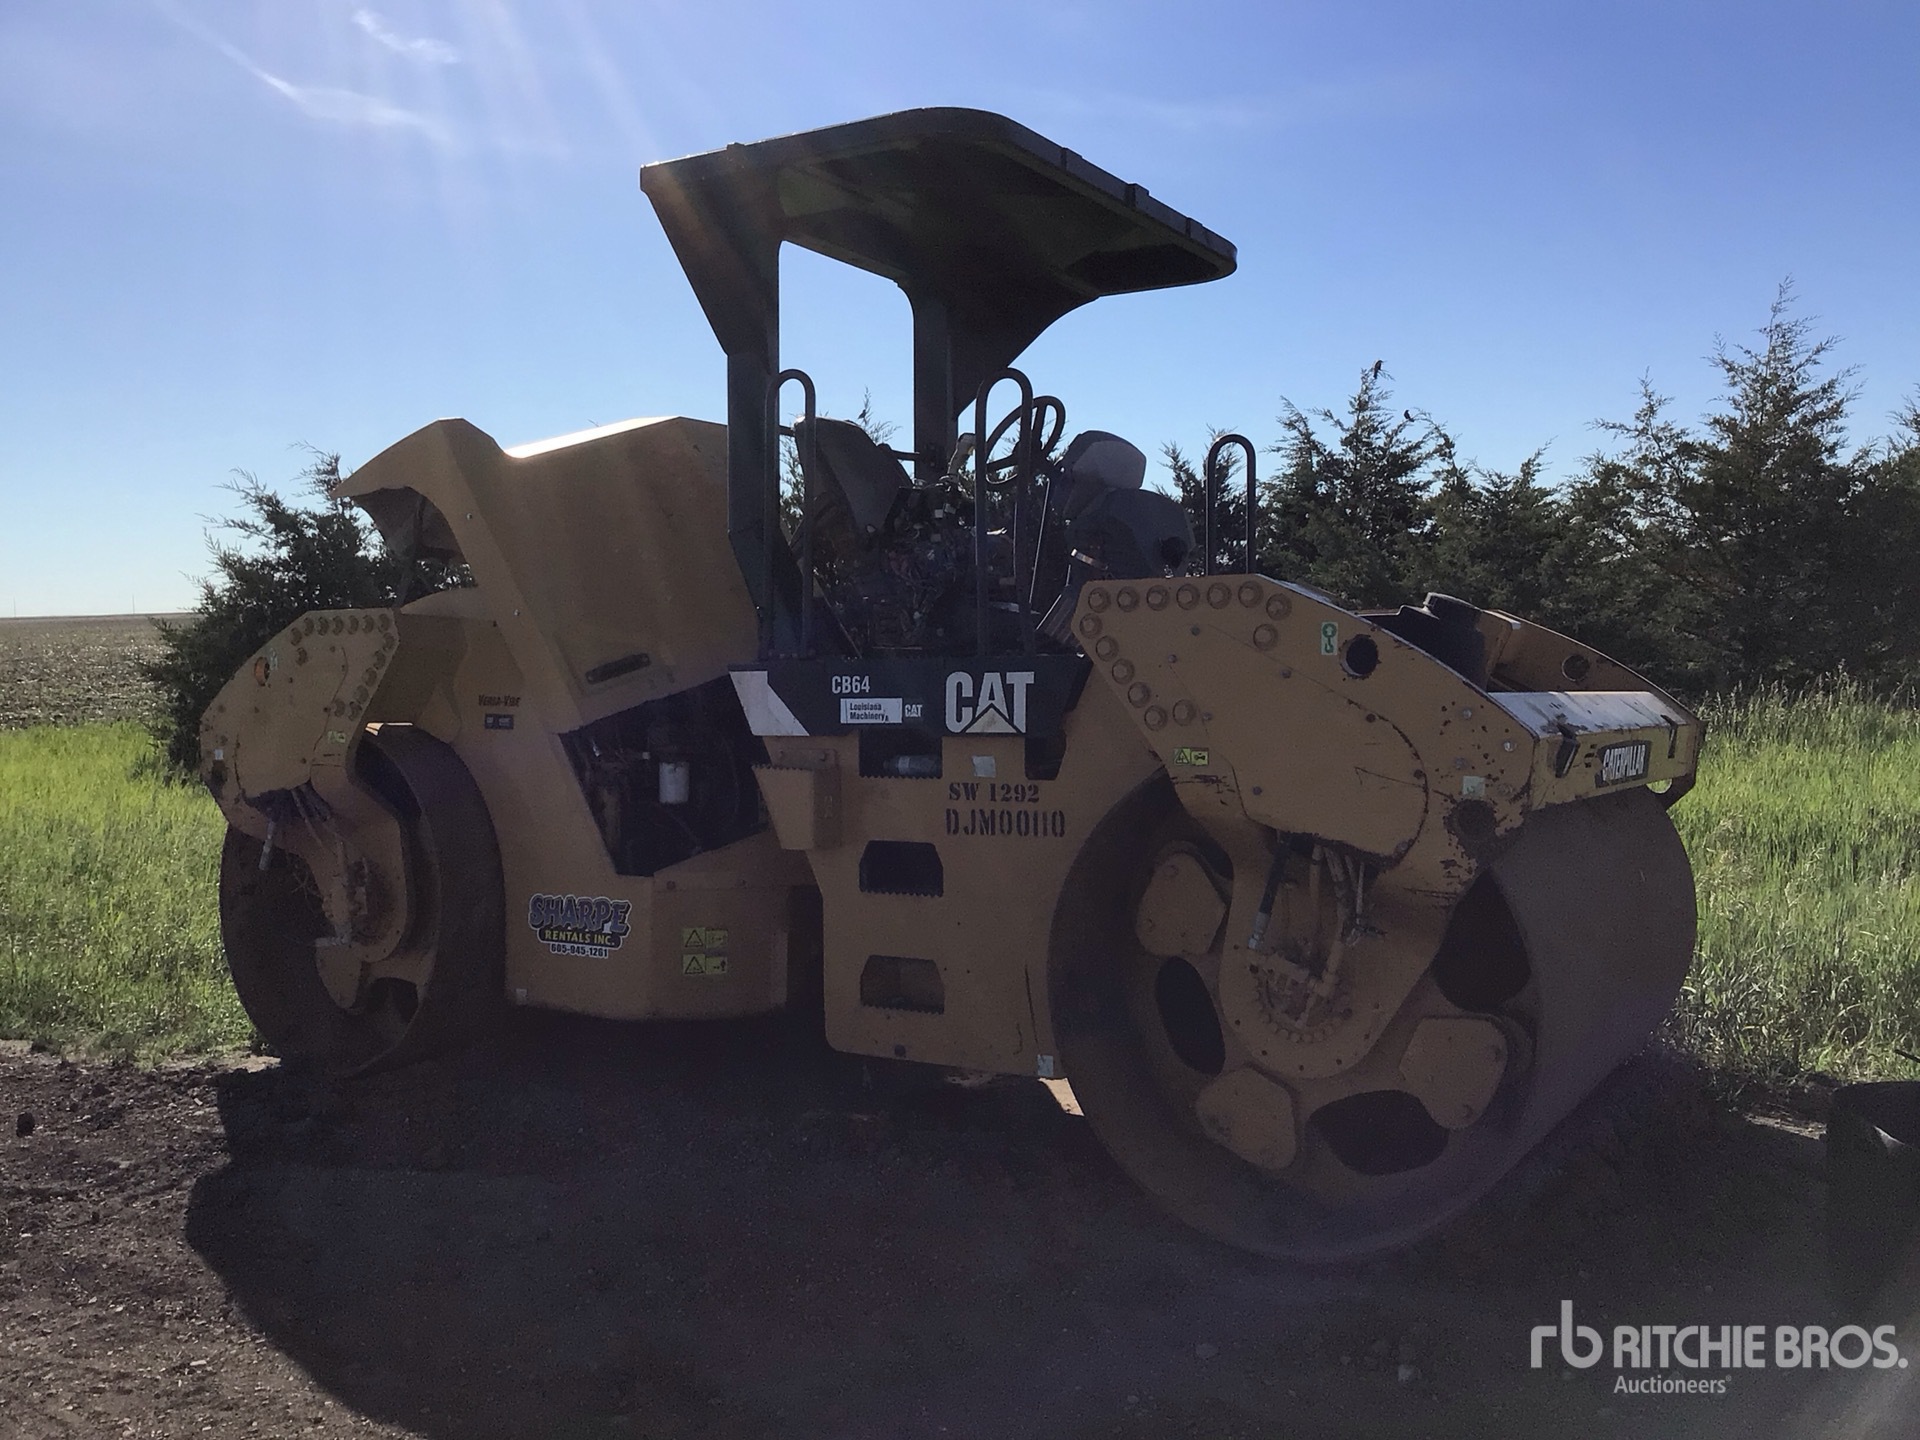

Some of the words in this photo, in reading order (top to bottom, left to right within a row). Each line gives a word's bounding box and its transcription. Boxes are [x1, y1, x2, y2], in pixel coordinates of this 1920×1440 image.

[831, 675, 870, 694] CB64
[849, 702, 882, 711] Louisiana
[904, 704, 922, 718] CAT
[945, 671, 1035, 733] CAT
[849, 711, 886, 723] Machinery
[1602, 744, 1646, 782] CATERPILLAR
[949, 783, 980, 801] SW
[988, 783, 1040, 803] 1292
[529, 894, 631, 936] SHARPE
[544, 929, 591, 944] RENTALS
[594, 934, 615, 946] INC.
